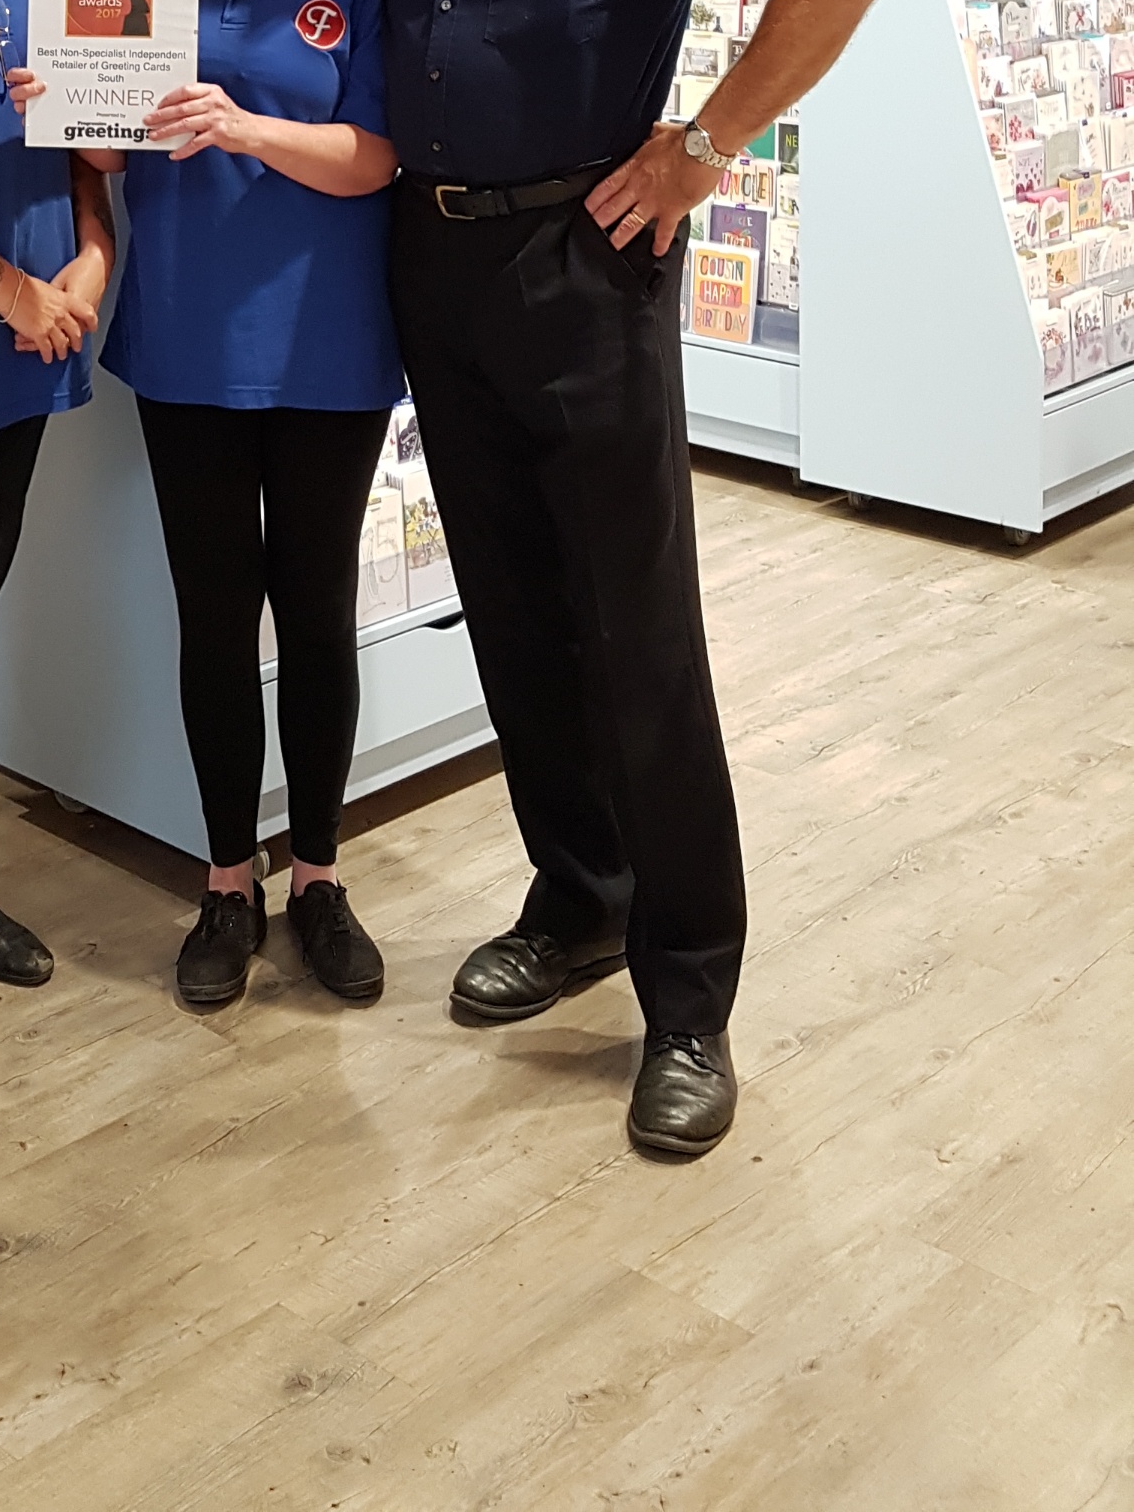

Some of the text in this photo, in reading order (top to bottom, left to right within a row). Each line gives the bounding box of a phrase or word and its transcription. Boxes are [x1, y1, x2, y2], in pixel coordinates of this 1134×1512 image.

[95, 8, 122, 19] 2017
[37, 47, 187, 61] Best Non-Specialist Independent
[52, 60, 171, 73] Retailer of Greeting Cards
[97, 73, 125, 83] South
[65, 88, 155, 107] WINNER
[719, 168, 769, 204] UNCLE
[698, 254, 744, 282] COUSIN
[703, 280, 740, 304] HAPPY
[695, 306, 748, 336] BIRTHDAY
